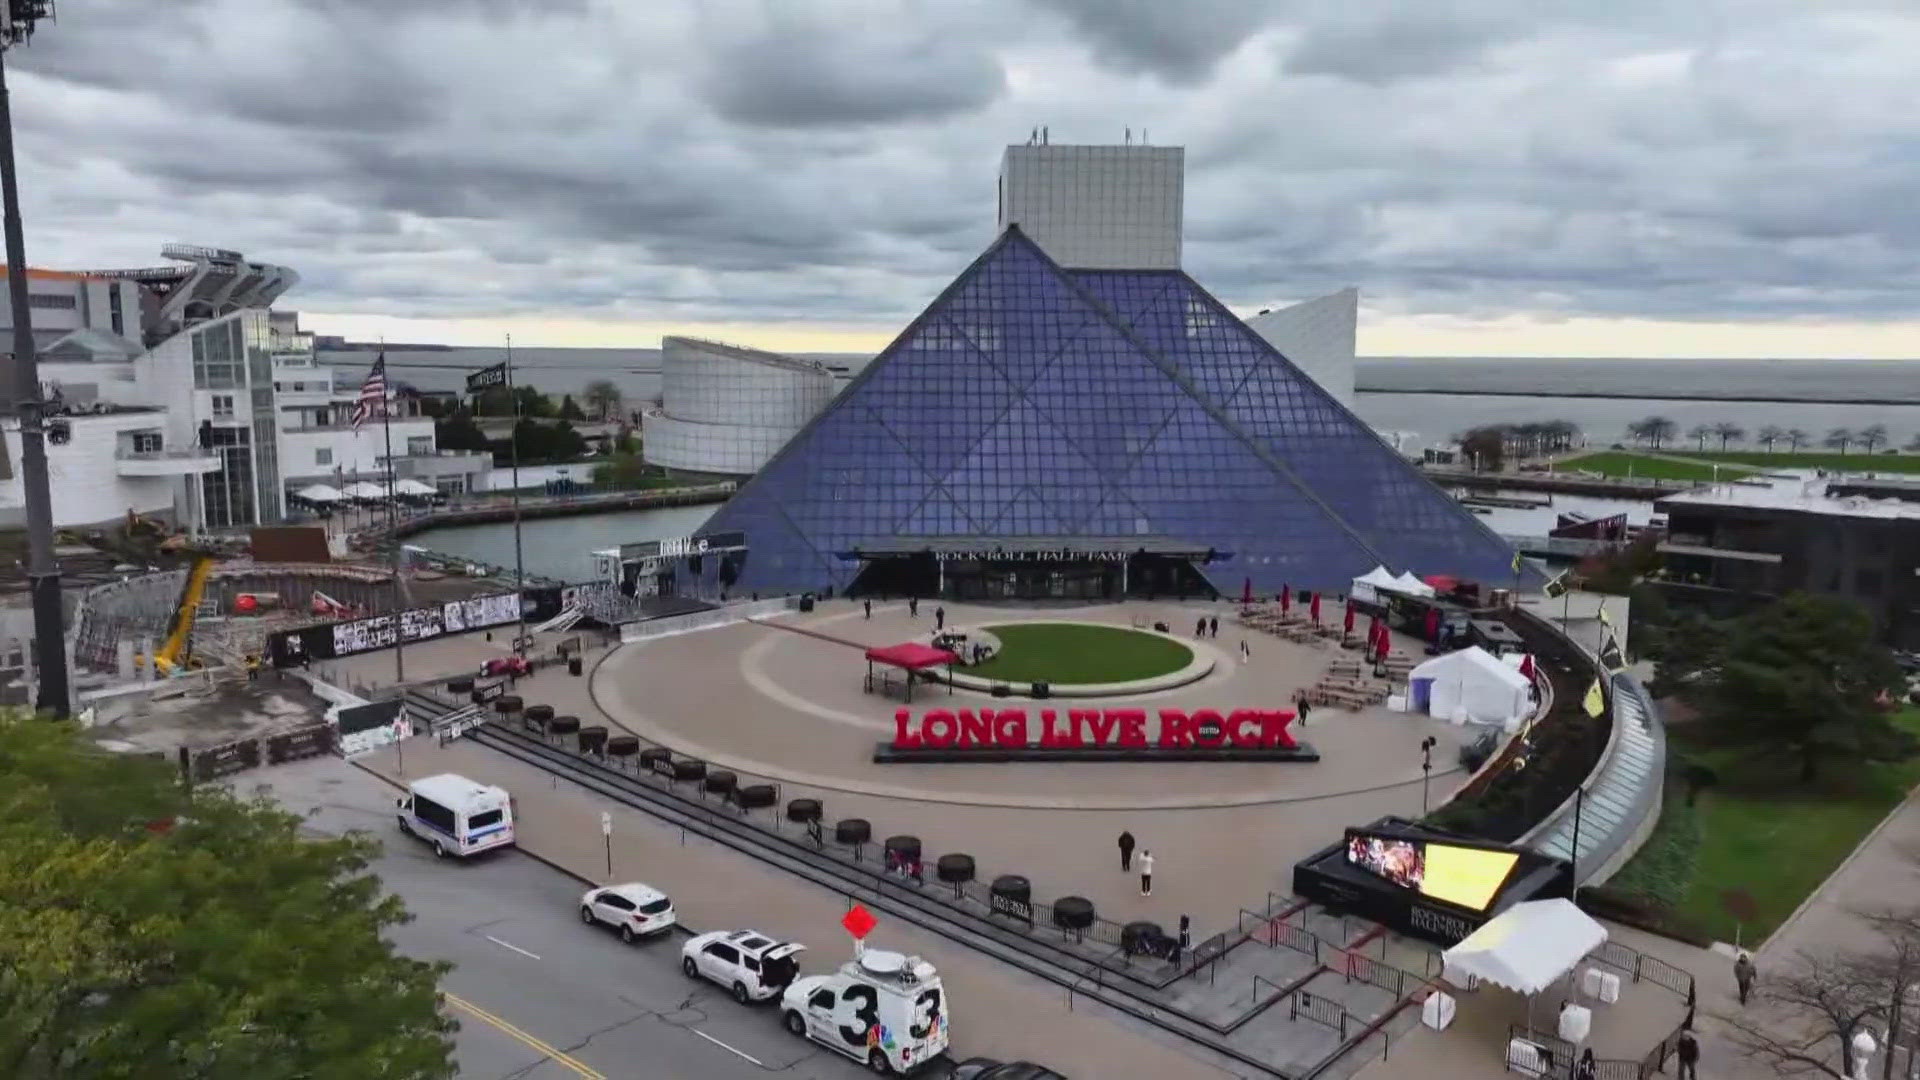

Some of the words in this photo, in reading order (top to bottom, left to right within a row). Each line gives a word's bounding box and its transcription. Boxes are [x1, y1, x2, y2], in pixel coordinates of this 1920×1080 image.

[936, 551, 978, 561] ROCK
[894, 708, 1027, 748] LONG
[1041, 708, 1147, 748] LIVE
[1159, 708, 1297, 748] ROCK
[839, 984, 880, 1046] 3
[910, 989, 941, 1039] 3
